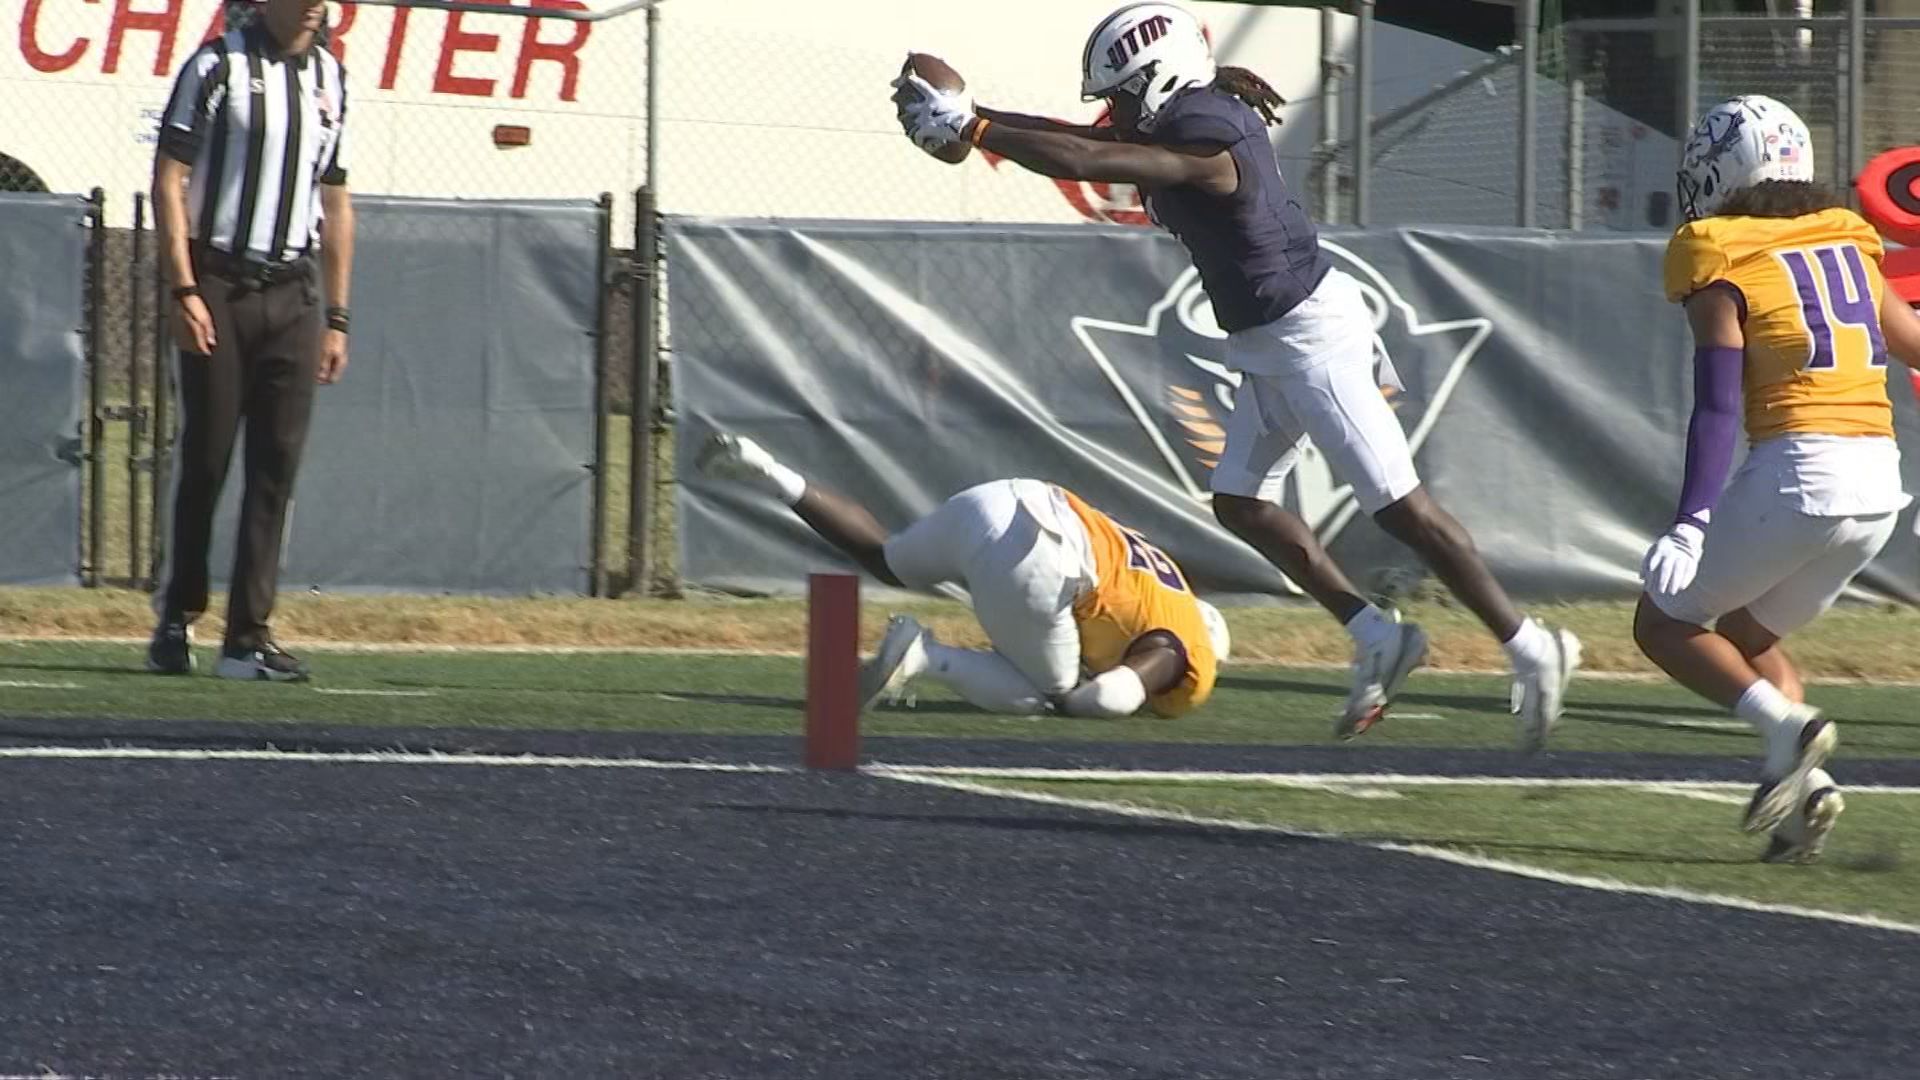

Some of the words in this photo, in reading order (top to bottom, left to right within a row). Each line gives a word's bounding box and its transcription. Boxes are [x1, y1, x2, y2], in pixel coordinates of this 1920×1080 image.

[19, 0, 590, 102] CHTER
[1104, 14, 1173, 72] UTM
[1771, 242, 1889, 372] 14
